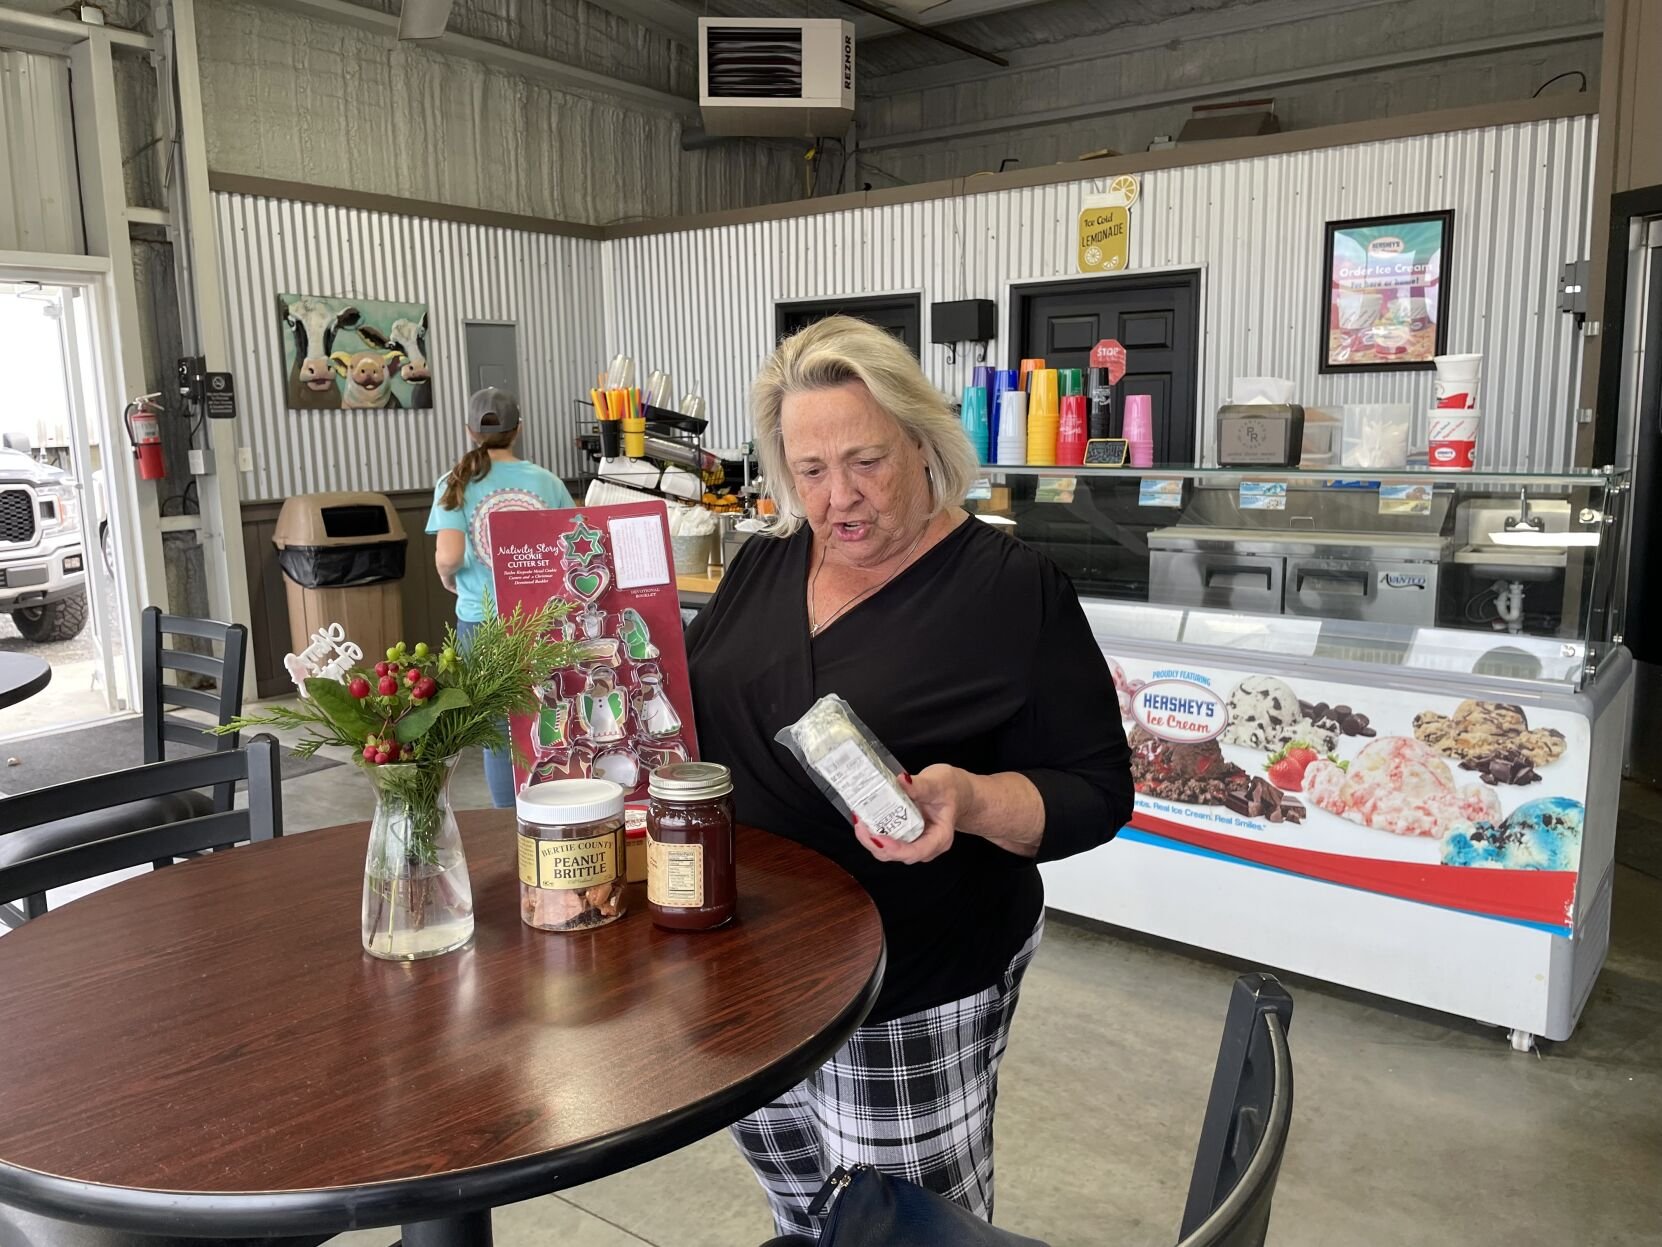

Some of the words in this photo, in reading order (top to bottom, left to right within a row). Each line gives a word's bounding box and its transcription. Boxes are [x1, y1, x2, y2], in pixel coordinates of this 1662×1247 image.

[1096, 212, 1113, 225] Cold
[1081, 223, 1123, 248] LEMONADE
[1340, 266, 1373, 278] Order
[1375, 265, 1392, 274] Ice
[1395, 263, 1432, 273] Cream
[1097, 347, 1120, 357] STOP
[497, 543, 533, 556] Nativity
[536, 542, 559, 556] Story
[513, 553, 543, 561] COOKIE
[507, 560, 536, 568] CUTTER
[537, 559, 550, 567] SET
[1152, 669, 1179, 679] PROUDLY
[1179, 670, 1211, 686] FEATURING
[1143, 693, 1215, 718] HERSHEY'S
[1147, 710, 1164, 727] Ice
[1167, 713, 1211, 734] Cream
[1153, 801, 1170, 812] Real
[1171, 805, 1183, 815] Ice
[1184, 808, 1213, 820] Cream.
[1214, 814, 1233, 825] Real
[541, 843, 576, 857] BERTIE
[578, 841, 614, 851] COUNTY
[553, 851, 606, 868] PEANUT
[553, 862, 607, 879] BRITTLE
